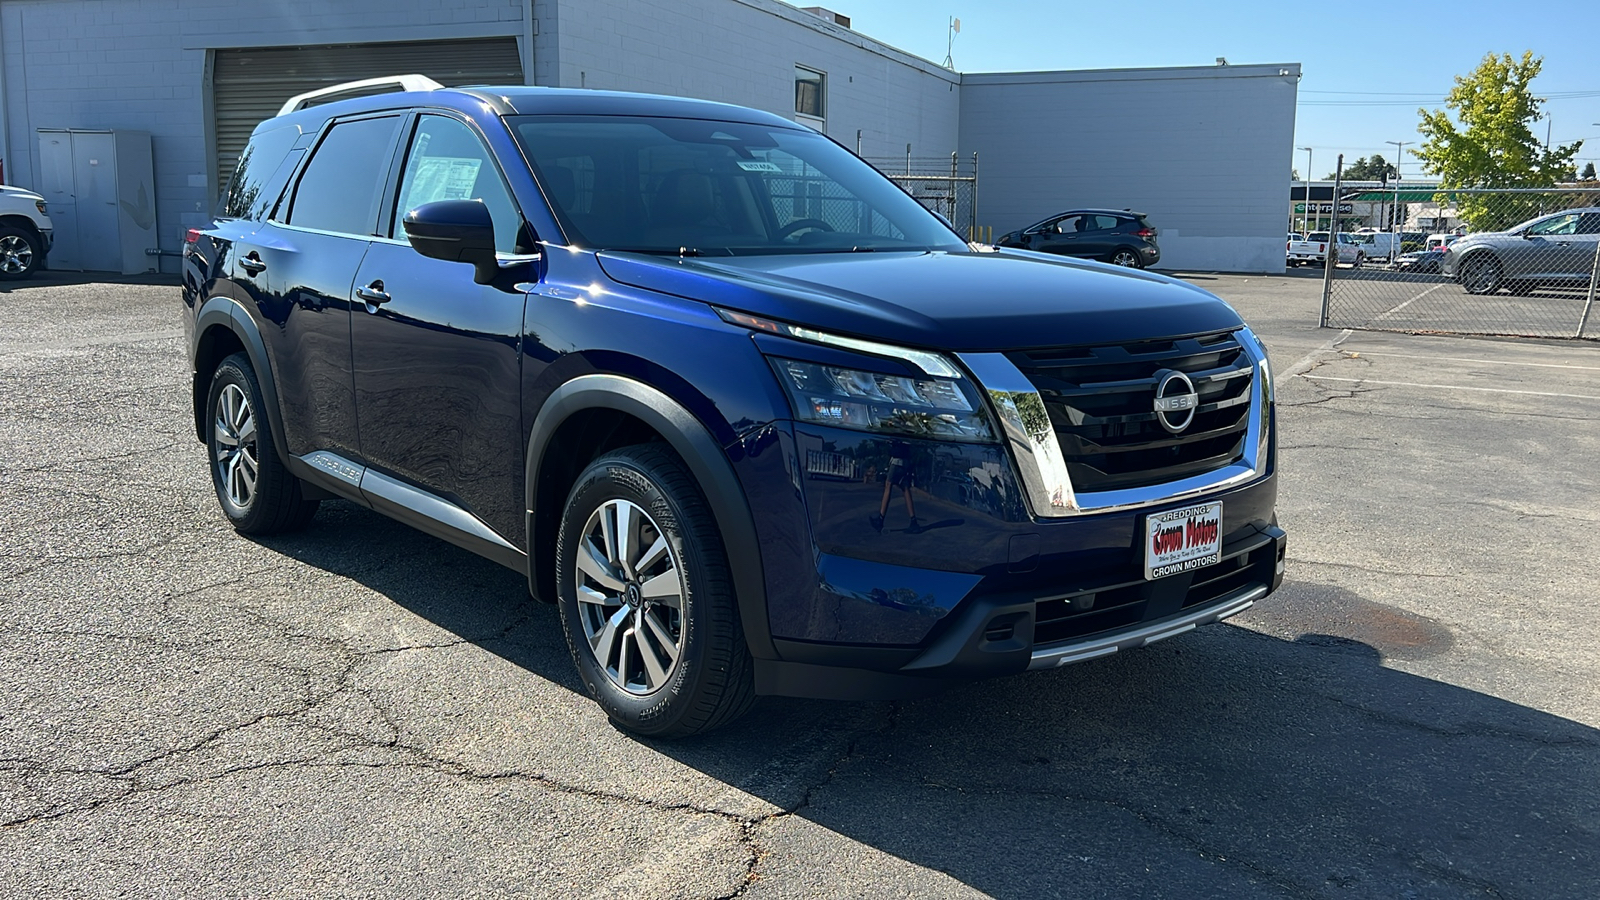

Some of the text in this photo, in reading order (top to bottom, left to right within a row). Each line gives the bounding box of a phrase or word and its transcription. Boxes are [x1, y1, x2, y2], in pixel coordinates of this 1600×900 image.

[1296, 203, 1351, 212] entrpise
[1155, 397, 1198, 409] NISSAN
[1167, 506, 1206, 521] REDDING
[1152, 517, 1218, 556] Crown Motors
[1153, 554, 1217, 577] CROWN MOTORS
